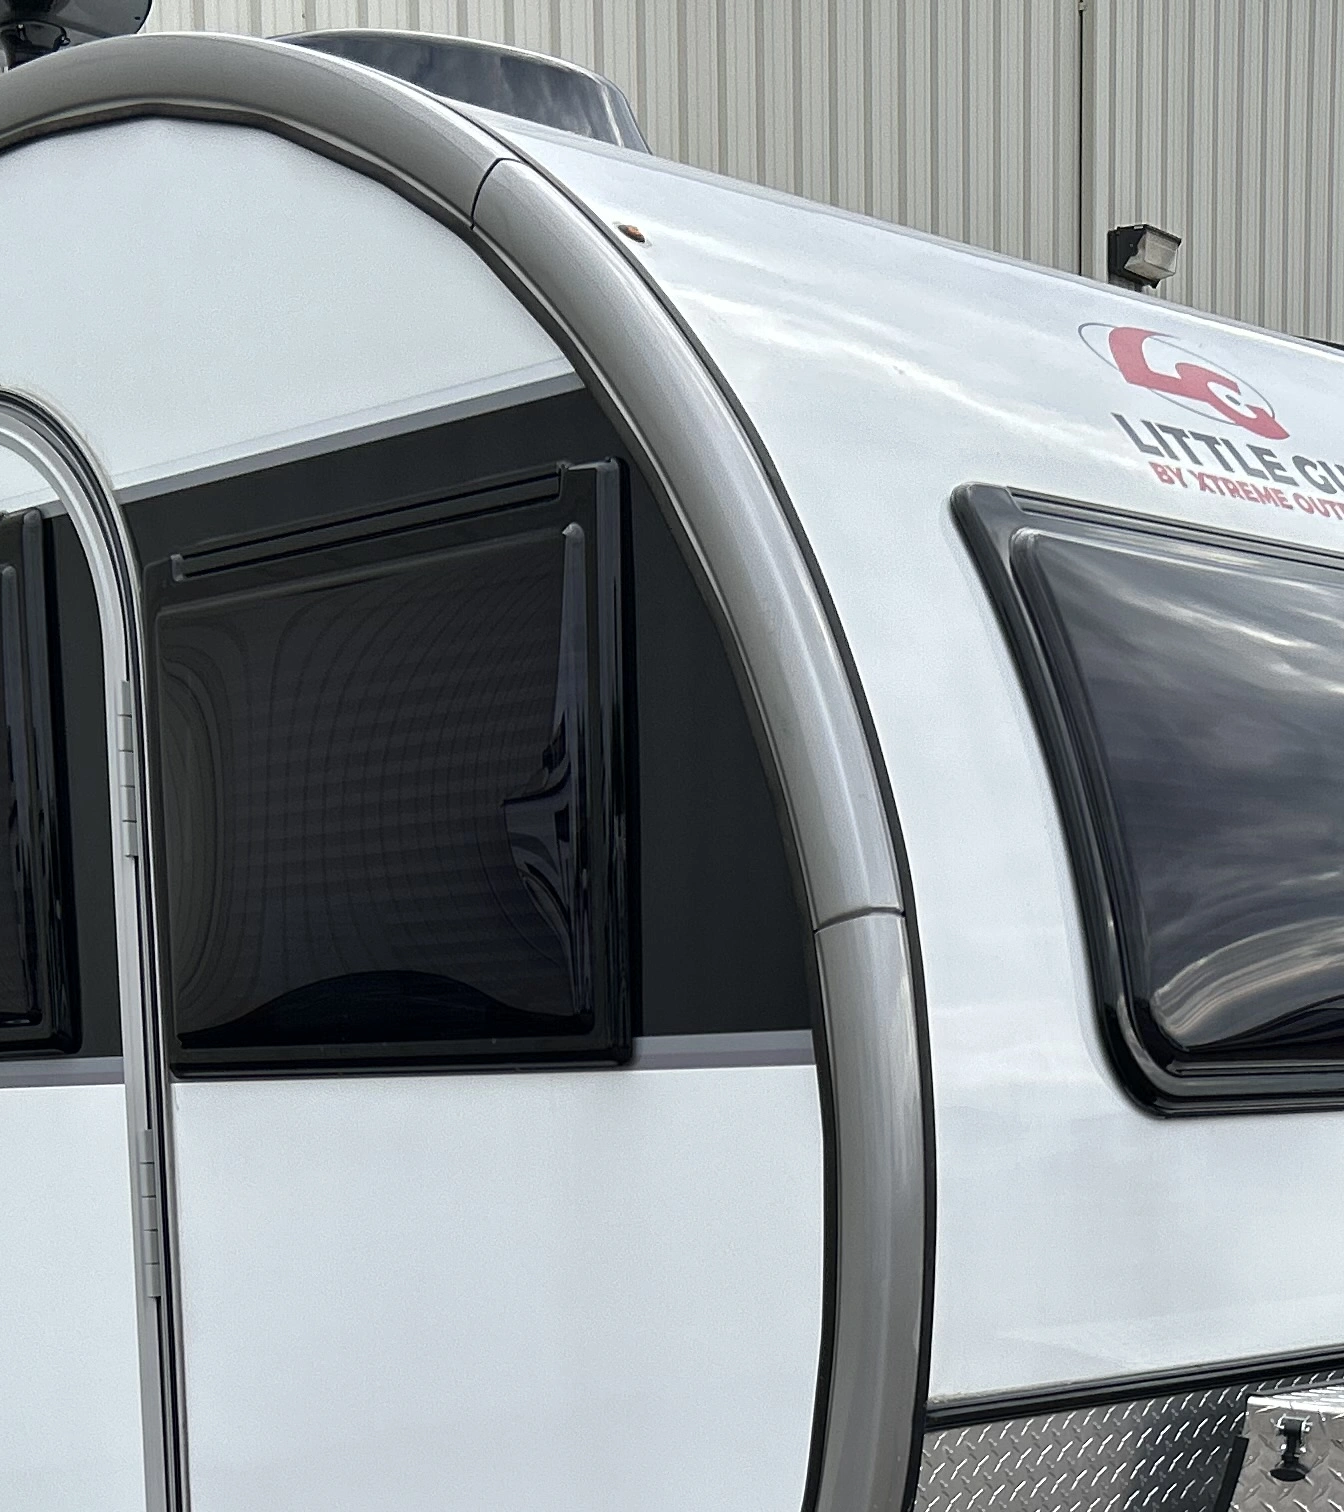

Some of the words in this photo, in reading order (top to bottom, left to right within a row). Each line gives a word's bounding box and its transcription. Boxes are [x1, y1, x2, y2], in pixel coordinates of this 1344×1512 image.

[1111, 412, 1299, 486] LITTLE
[1148, 461, 1188, 488] BY
[1187, 468, 1293, 510] XTREME
